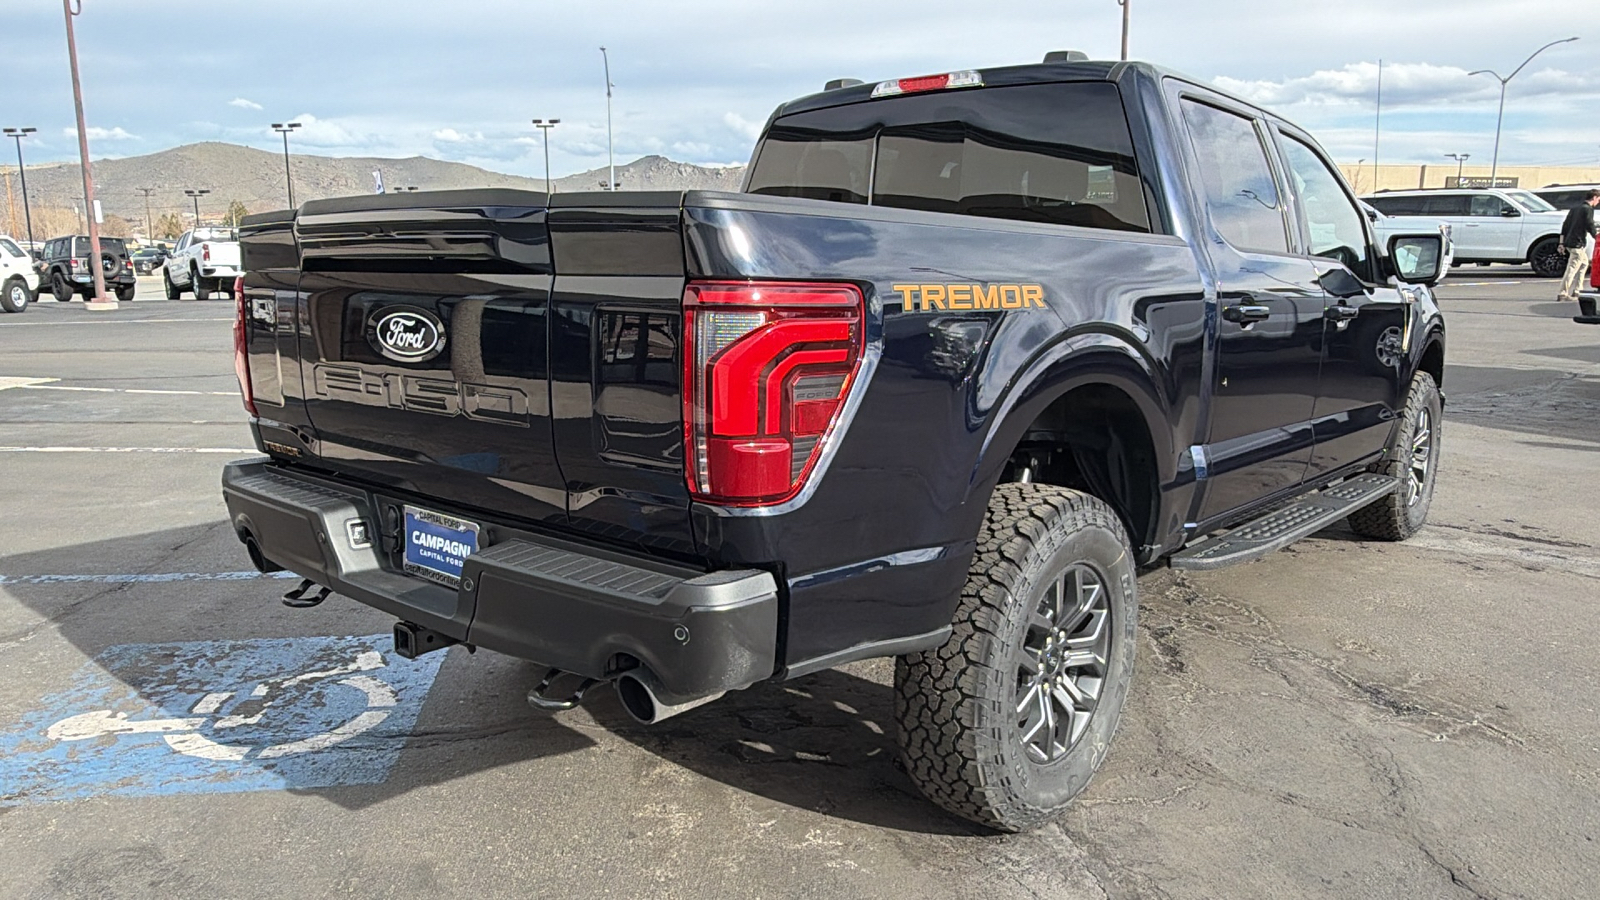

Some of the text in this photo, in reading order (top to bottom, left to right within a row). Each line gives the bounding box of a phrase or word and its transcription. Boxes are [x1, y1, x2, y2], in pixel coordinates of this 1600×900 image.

[892, 283, 1047, 312] TREMOR
[386, 317, 426, 349] Ford
[312, 361, 531, 429] F-150
[419, 512, 460, 528] CAPITAL FORD
[412, 531, 471, 558] CAMPAGNI
[419, 549, 463, 567] CAPITAL FORD
